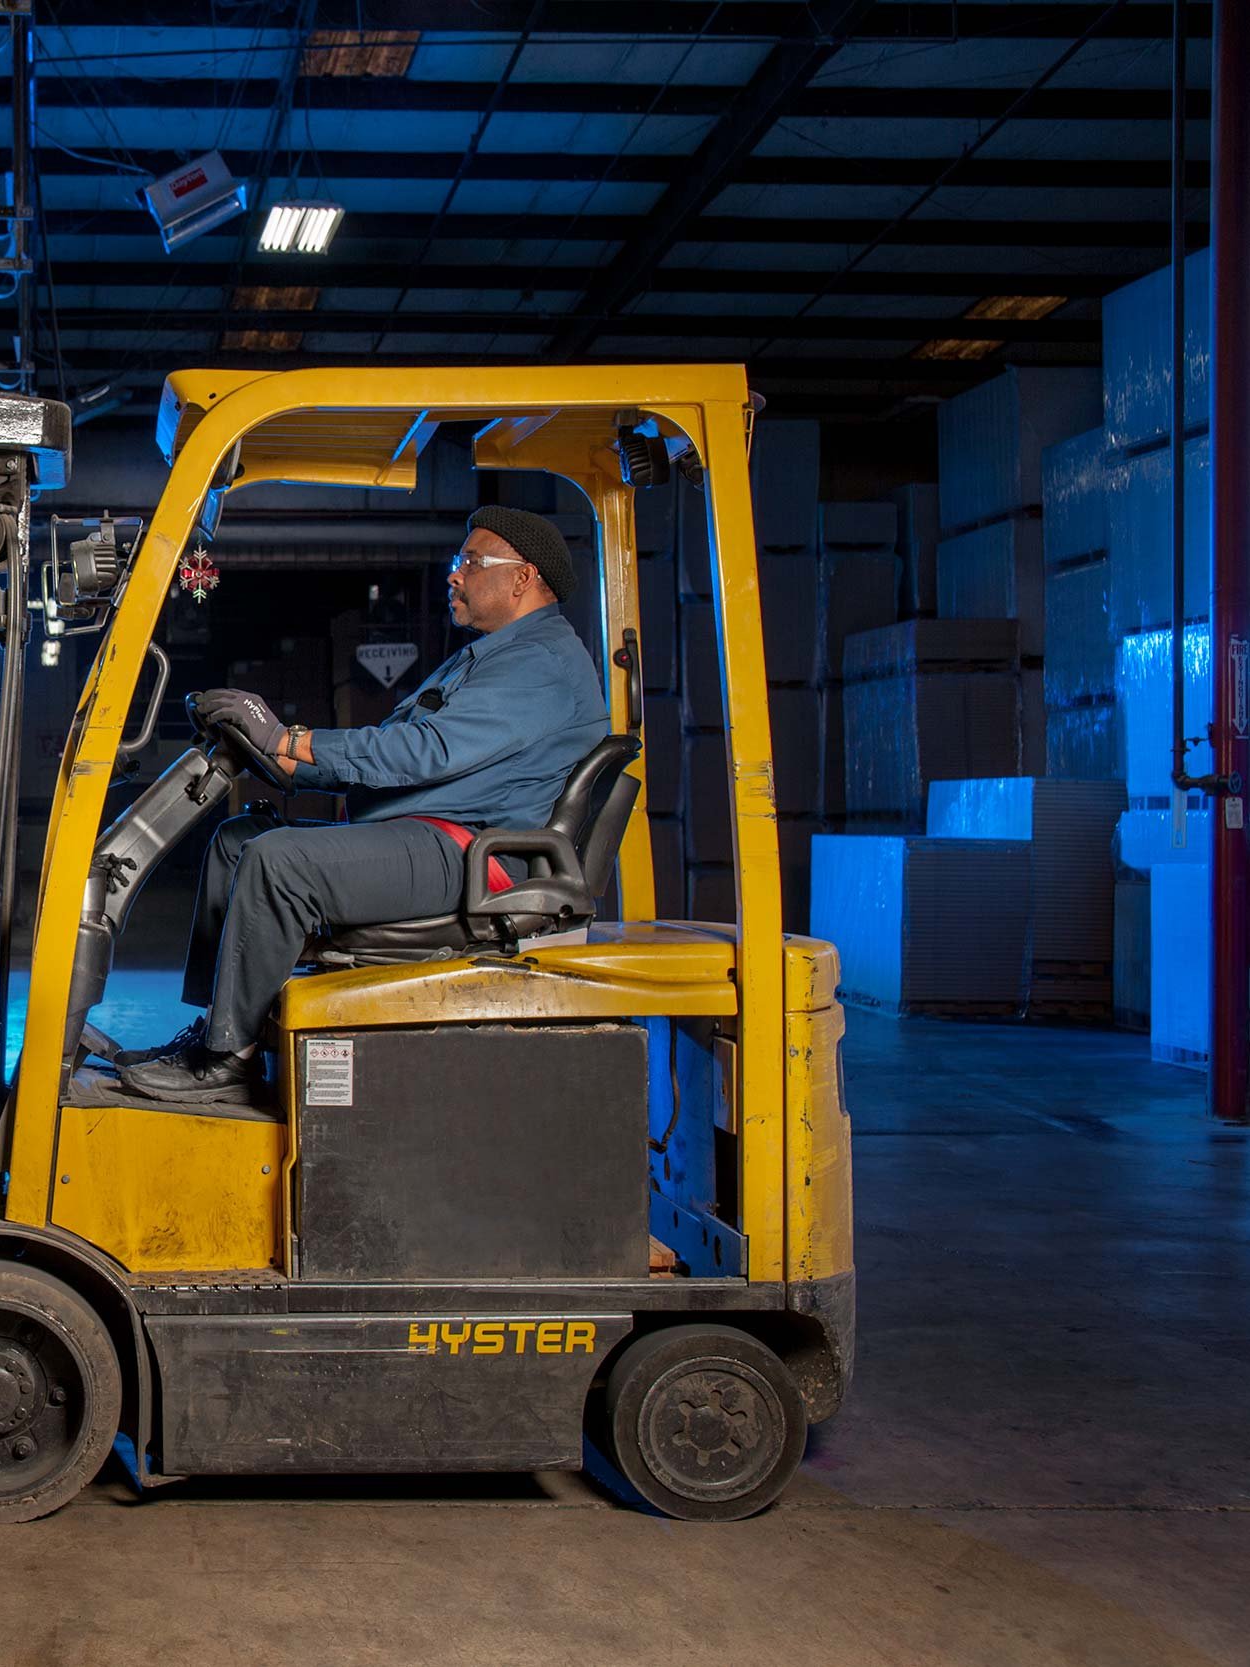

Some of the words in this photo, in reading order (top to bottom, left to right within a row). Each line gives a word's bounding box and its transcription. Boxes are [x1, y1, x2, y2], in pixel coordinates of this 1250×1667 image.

[358, 646, 416, 658] RECEIVING
[1232, 644, 1248, 655] FIRE
[408, 1322, 596, 1354] HYSTER
